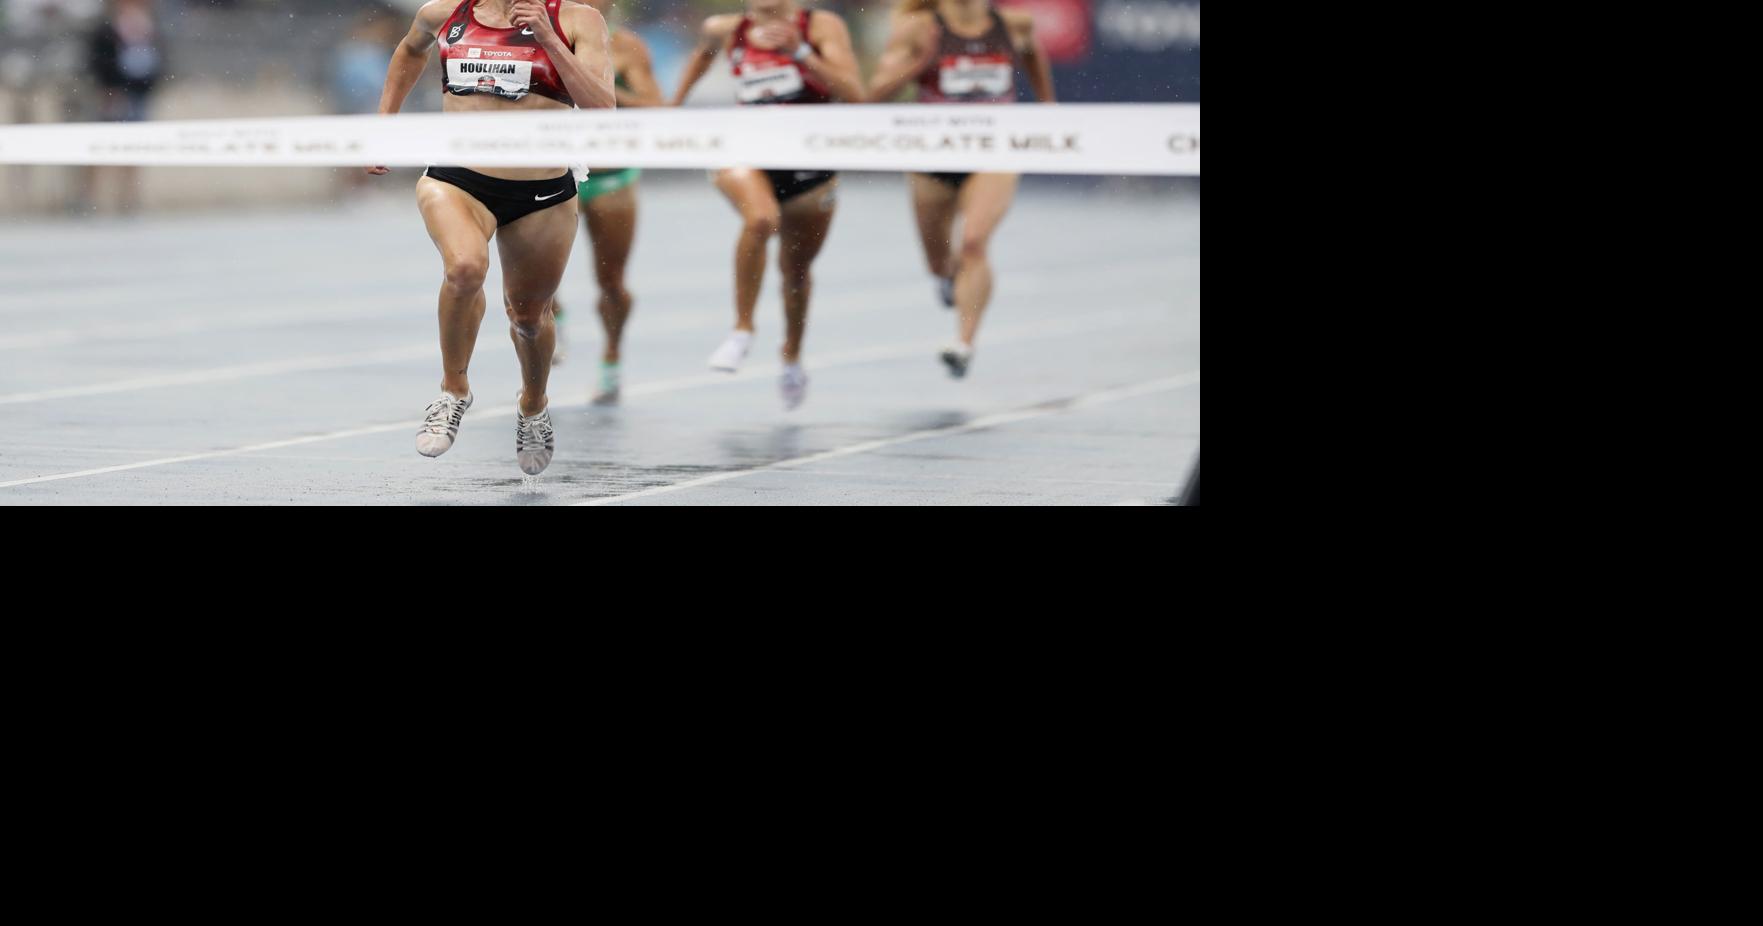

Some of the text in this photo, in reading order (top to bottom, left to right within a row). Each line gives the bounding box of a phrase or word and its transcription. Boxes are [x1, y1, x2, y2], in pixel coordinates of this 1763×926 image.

[460, 62, 516, 74] HOULIHAN
[804, 134, 1081, 152] CHOCOLATE MILK
